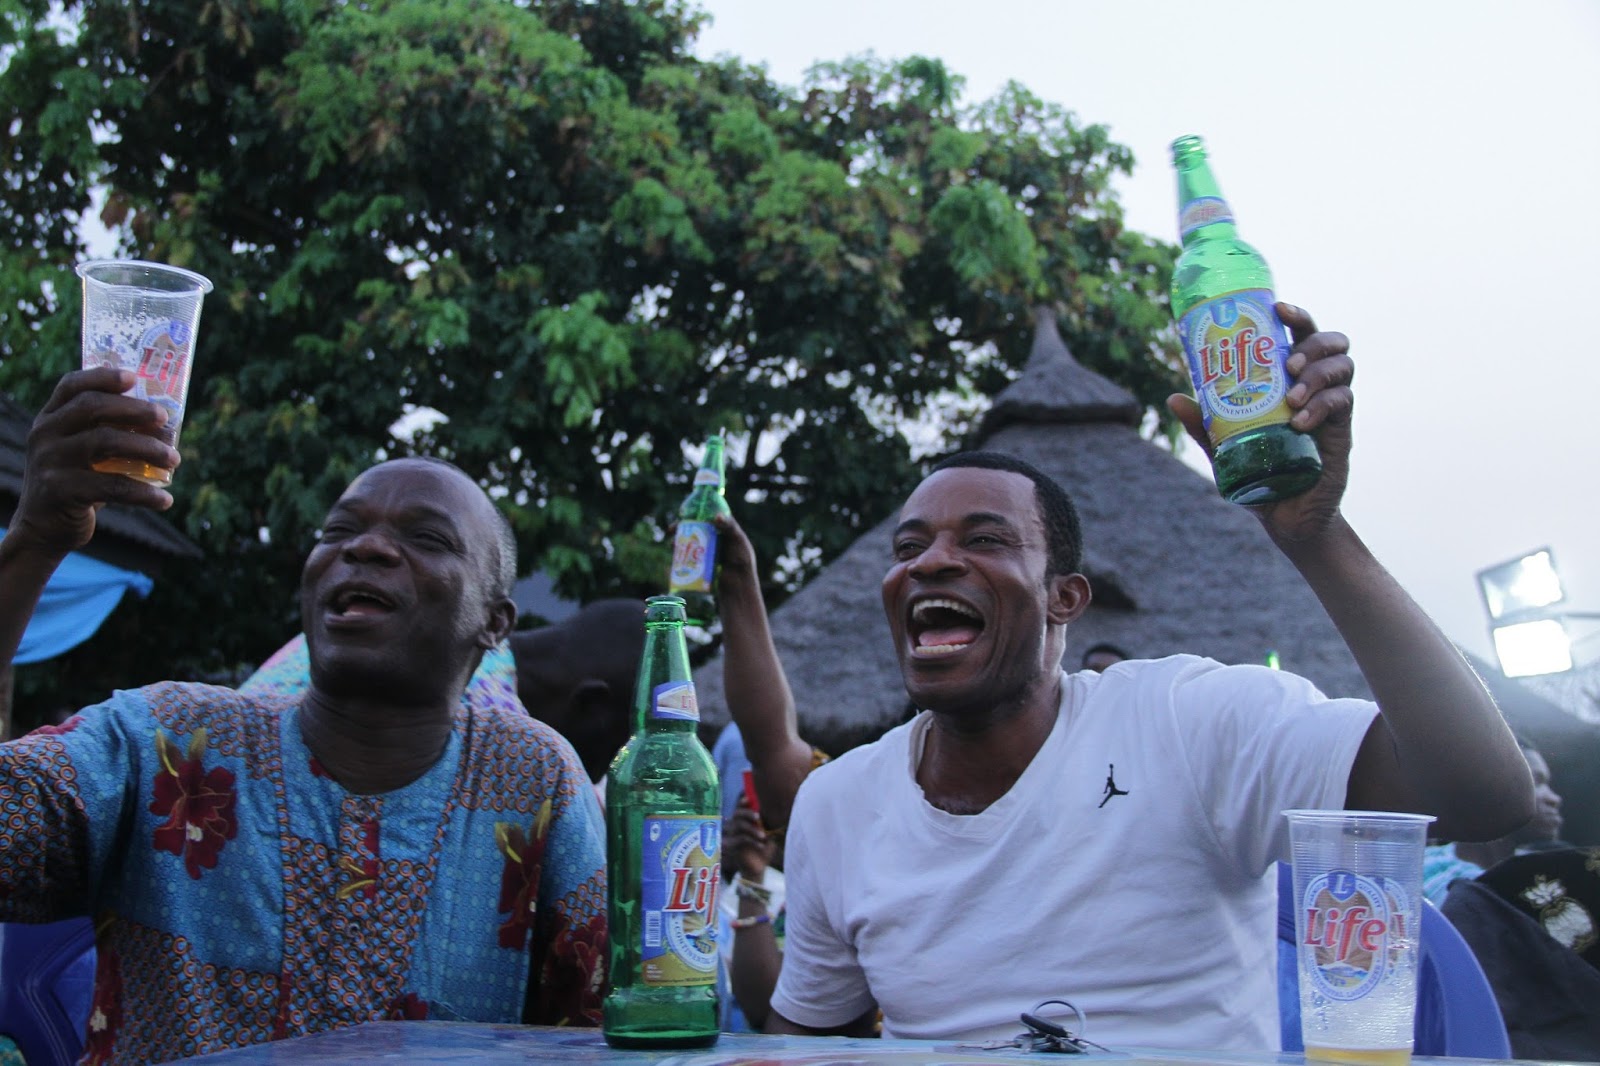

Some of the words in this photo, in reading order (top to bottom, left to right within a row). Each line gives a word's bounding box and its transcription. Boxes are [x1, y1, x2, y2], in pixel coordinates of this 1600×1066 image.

[1199, 328, 1275, 385] Life
[1211, 393, 1253, 415] CONTINENTAL
[1255, 394, 1275, 410] LAGER
[675, 835, 699, 864] PREMIUM
[1304, 907, 1387, 961] Life
